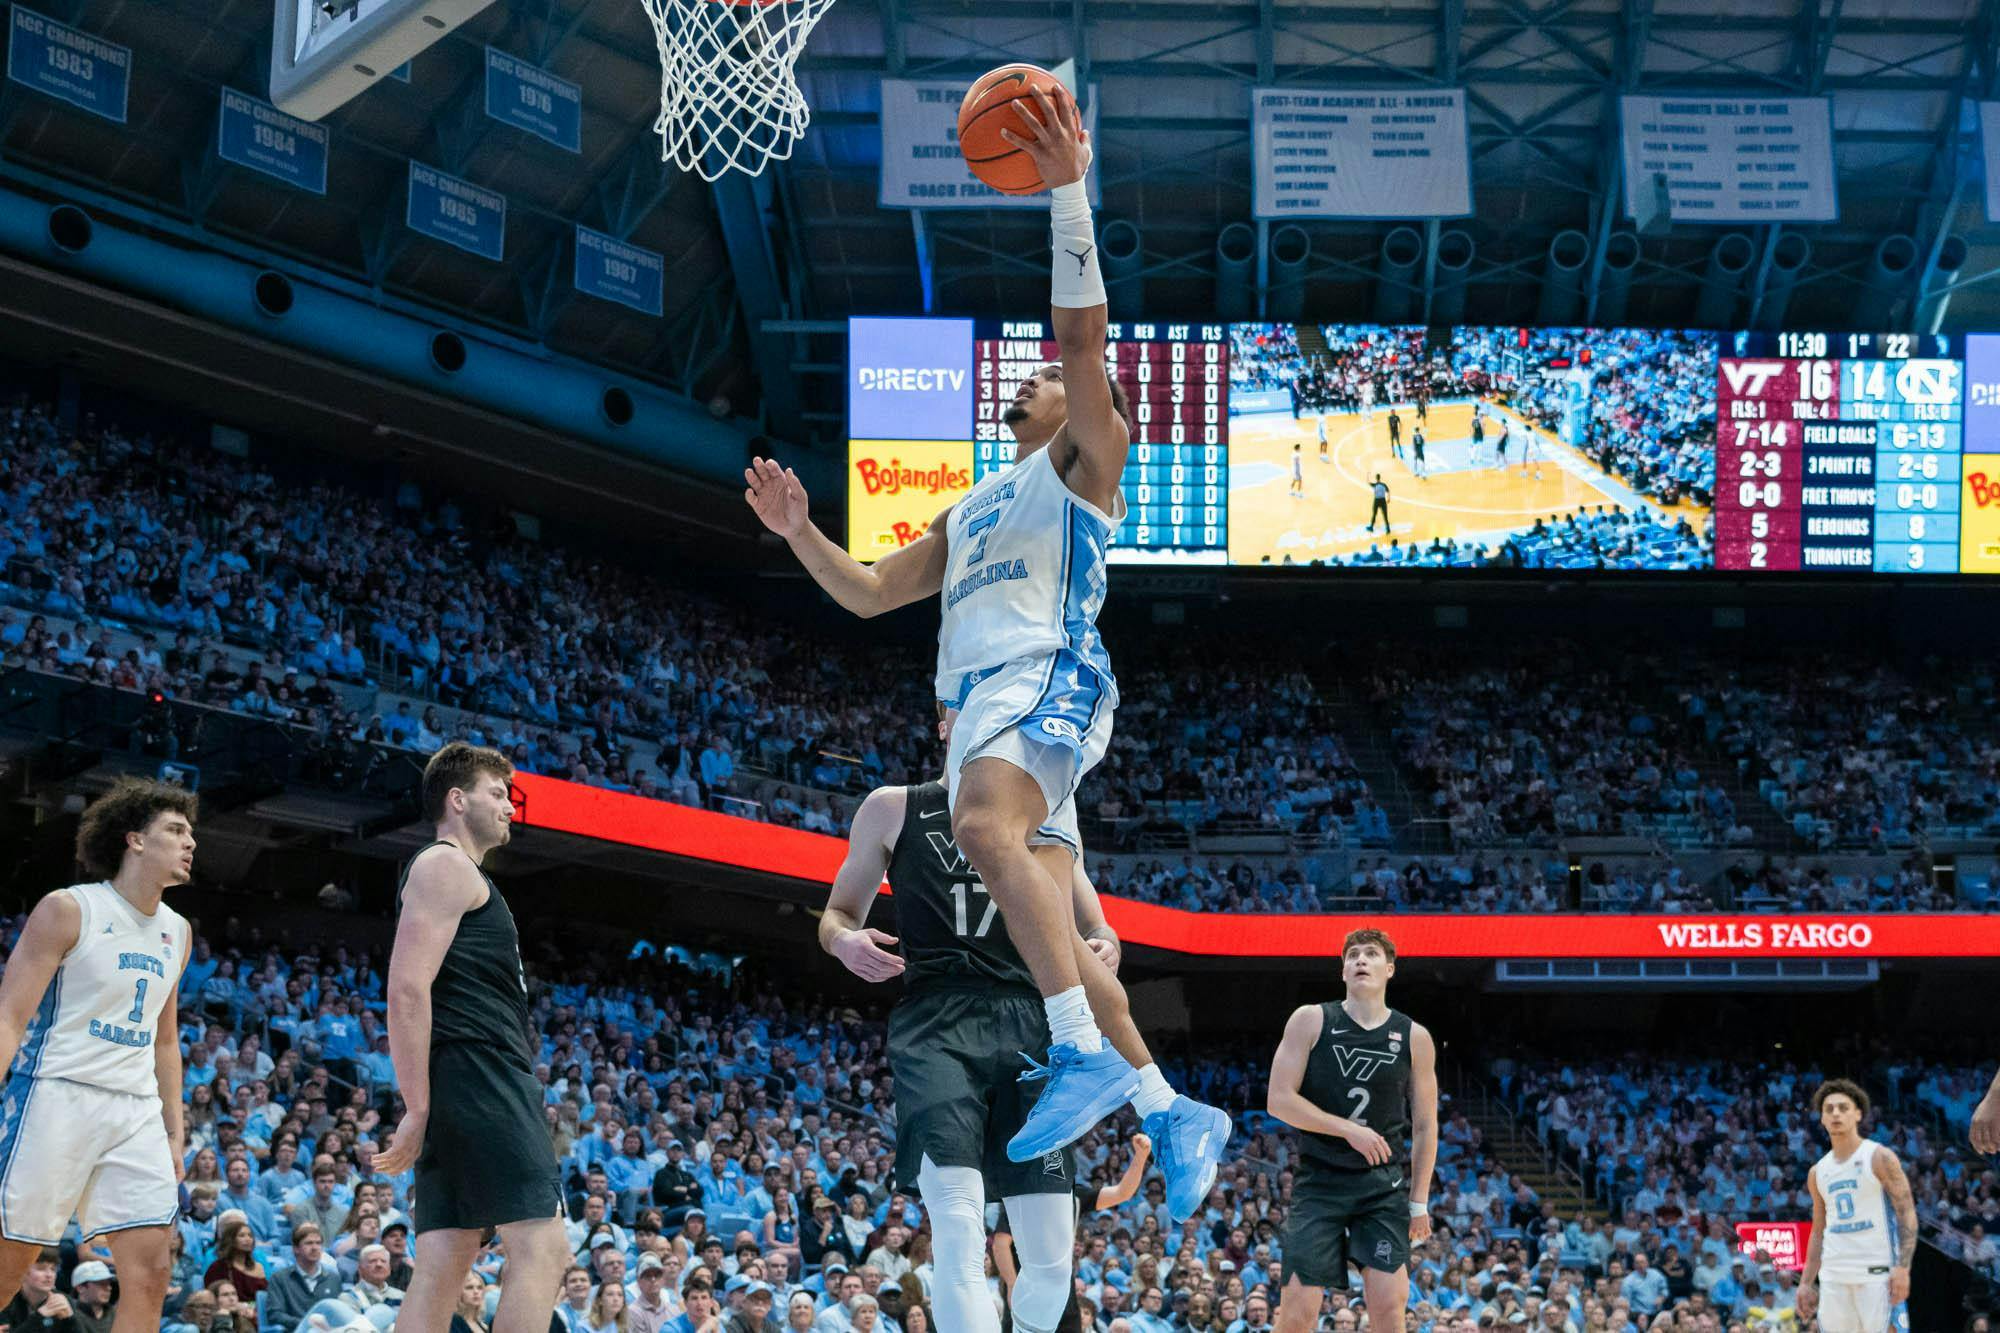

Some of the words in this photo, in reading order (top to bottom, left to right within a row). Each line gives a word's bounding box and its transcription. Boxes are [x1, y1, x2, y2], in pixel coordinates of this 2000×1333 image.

[16, 12, 44, 35] ACC
[46, 24, 126, 67] CHAMPIONS
[47, 46, 94, 80] 1983
[515, 65, 579, 104] CHAMPIONS
[224, 94, 251, 116] ACC
[1261, 95, 1319, 107] FIRST-TEAM
[1322, 96, 1376, 108] ACADEMIC
[253, 124, 296, 157] 1984
[438, 176, 502, 213] CHAMPIONS
[909, 184, 956, 197] COACH
[440, 195, 477, 226] 1985
[603, 240, 660, 272] CHAMPIONS
[604, 258, 638, 284] 1987
[1003, 322, 1043, 339] PLAYER
[1107, 324, 1121, 339] TS
[1134, 324, 1155, 340] REB
[1168, 326, 1189, 341] AST
[1202, 326, 1222, 341] FLS
[1778, 332, 1827, 357] 11:30
[1886, 334, 1909, 358] 22
[982, 340, 992, 360] 1
[998, 340, 1044, 360] LAWAL
[1139, 342, 1149, 362] 1
[1171, 343, 1185, 363] 0
[1204, 343, 1218, 363] 0
[858, 367, 967, 391] DIRECTV
[980, 360, 993, 380] 2
[1137, 363, 1151, 382] 0
[1171, 363, 1185, 383] 0
[1204, 363, 1218, 383] 0
[1720, 361, 1786, 397] VT
[1797, 360, 1832, 400] 16
[1850, 361, 1886, 401] 14
[980, 380, 993, 400] 3
[1139, 383, 1149, 403] 1
[1171, 383, 1185, 403] 3
[1204, 384, 1218, 403] 0
[978, 401, 995, 421] 17
[1137, 403, 1151, 423] 0
[1172, 403, 1182, 423] 1
[1204, 404, 1218, 423] 0
[975, 422, 997, 441] 32
[1139, 424, 1149, 443] 1
[1171, 424, 1185, 443] 0
[1204, 424, 1218, 444] 0
[1734, 421, 1787, 446] 7-14
[1804, 426, 1837, 444] FIELD
[1838, 426, 1876, 444] GOALS
[1892, 423, 1945, 448] 6-13
[981, 442, 993, 461] 0
[1137, 444, 1151, 463] 0
[1172, 444, 1182, 464] 1
[1204, 444, 1218, 464] 0
[1739, 451, 1782, 477] 2-3
[1808, 457, 1817, 474] 3
[1818, 457, 1854, 475] POINT
[1855, 457, 1871, 475] FG
[1898, 454, 1938, 479] 2-6
[856, 458, 970, 496] Bojangles
[1139, 465, 1149, 484] 1
[1170, 465, 1184, 484] 0
[1203, 465, 1217, 484] 0
[959, 481, 1016, 525] NORTH
[1137, 485, 1151, 504] 0
[1170, 485, 1184, 504] 0
[1203, 485, 1217, 504] 0
[1738, 482, 1782, 507] 0-0
[1802, 487, 1829, 505] FREE
[1830, 487, 1876, 505] THROWS
[1897, 484, 1938, 509] 0-0
[1139, 505, 1149, 524] 1
[1170, 505, 1184, 524] 0
[1203, 505, 1217, 525] 0
[1751, 512, 1769, 538] 5
[1807, 517, 1869, 536] REBOUNDS
[1908, 515, 1925, 540] 8
[968, 508, 999, 567] 7
[1136, 525, 1150, 545] 2
[1171, 525, 1181, 545] 1
[1203, 525, 1217, 546] 0
[1750, 542, 1767, 568] 2
[1804, 547, 1872, 566] TURNOVERS
[1908, 545, 1925, 569] 3
[947, 559, 1028, 611] CAROLINA
[949, 883, 999, 937] 17
[1657, 923, 1764, 949] WELLS
[1769, 923, 1873, 949] FARGO
[128, 978, 149, 1023] 1
[1332, 1044, 1398, 1081] VT
[1347, 1087, 1370, 1126] 2
[1835, 1192, 1855, 1220] 0
[1756, 1229, 1794, 1243] FARM
